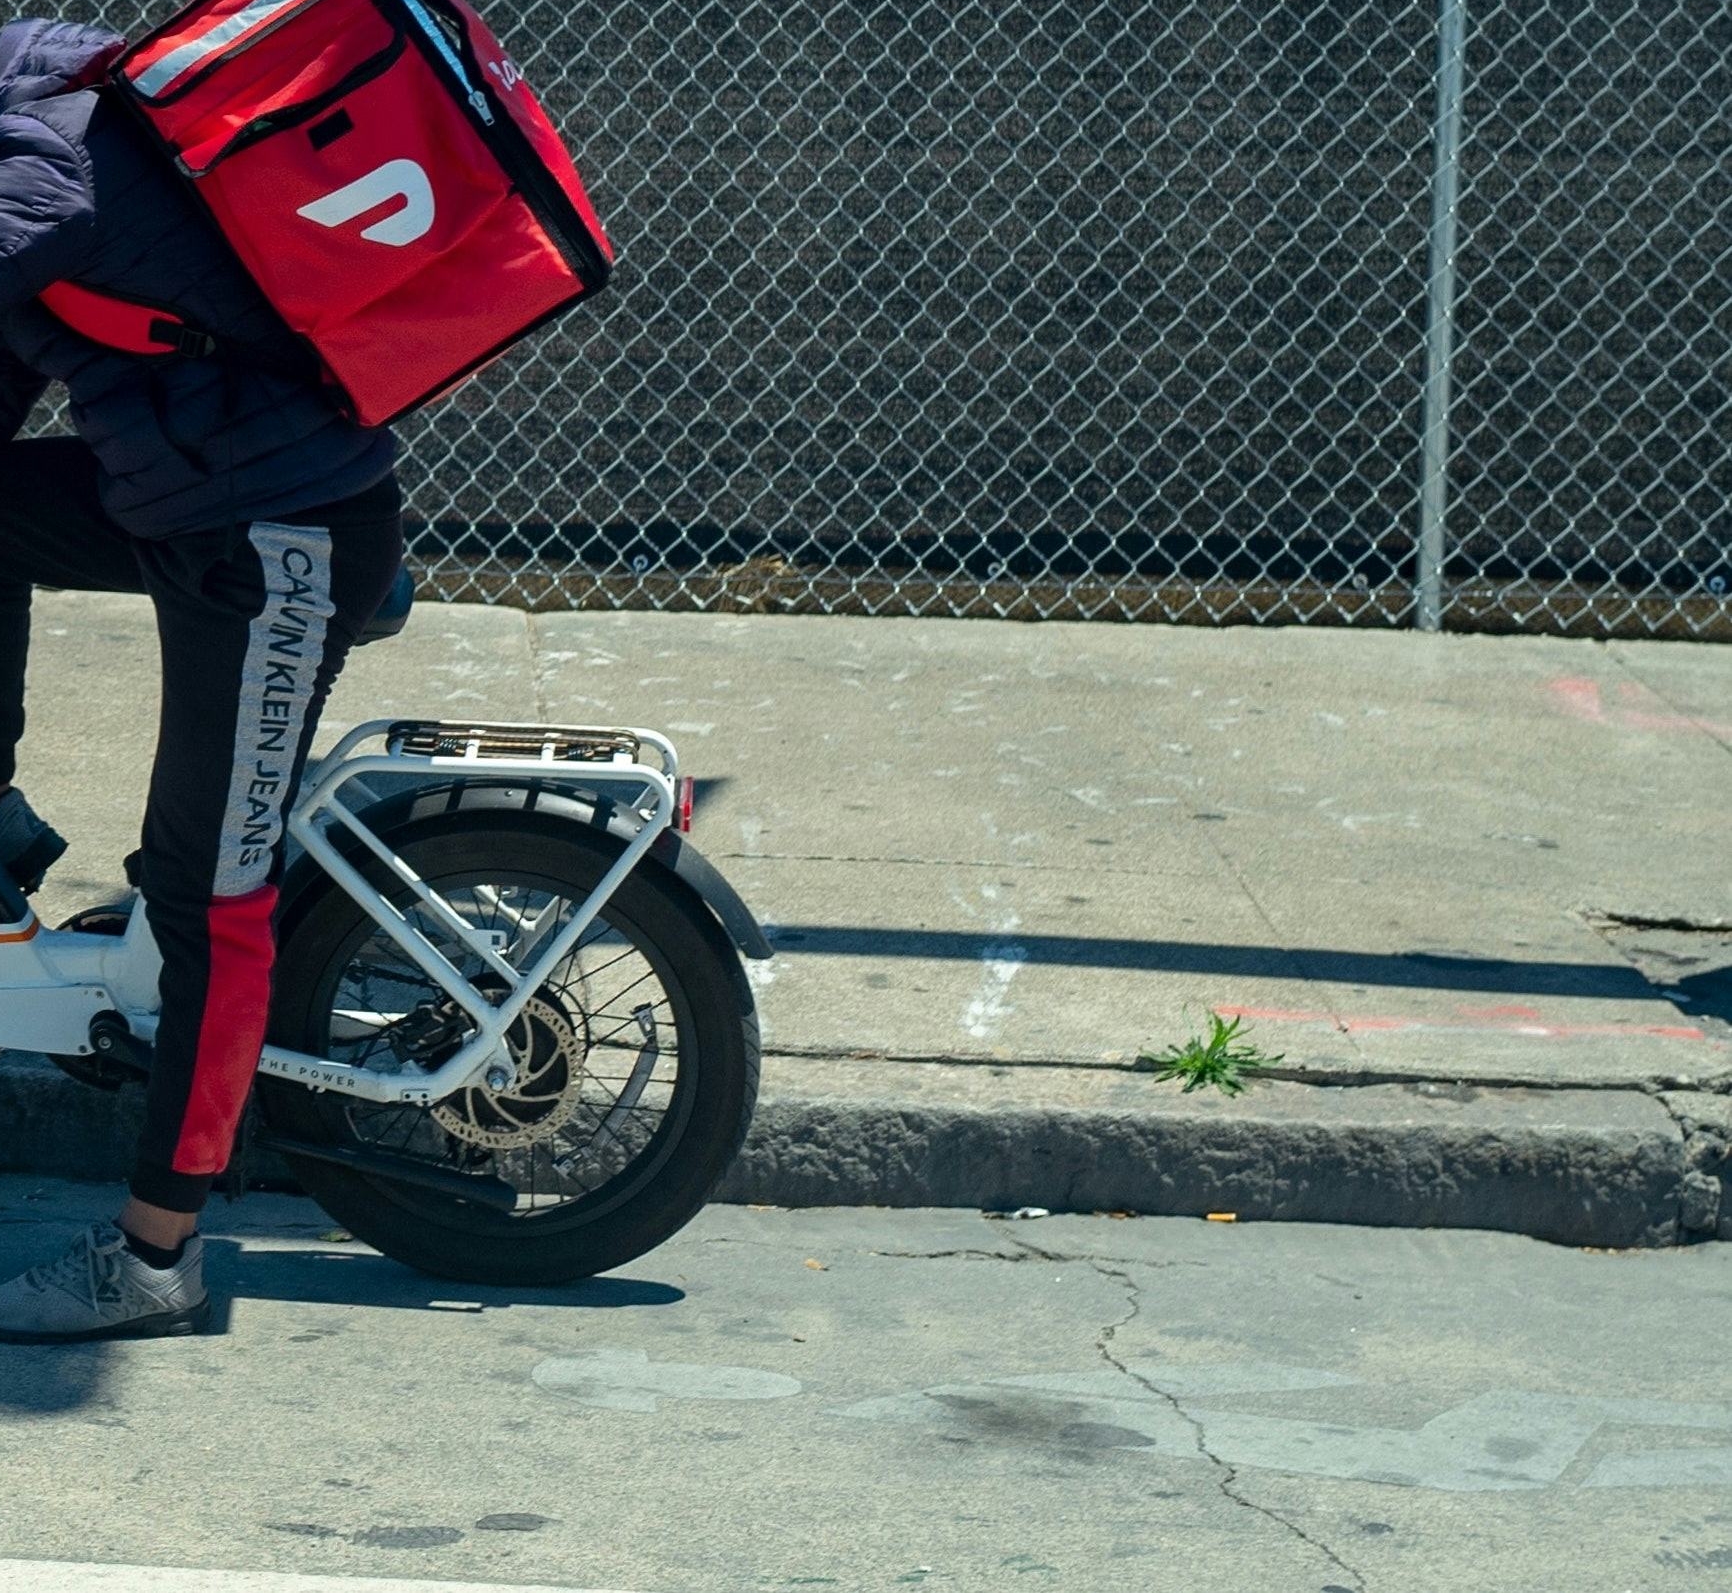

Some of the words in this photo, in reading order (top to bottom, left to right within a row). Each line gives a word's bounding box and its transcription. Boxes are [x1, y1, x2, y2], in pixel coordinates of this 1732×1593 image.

[269, 547, 316, 658] CALVIN
[256, 660, 297, 752] KLEIN
[239, 760, 280, 866] JEANS
[259, 1058, 289, 1072] THE
[299, 1066, 355, 1088] POWER
